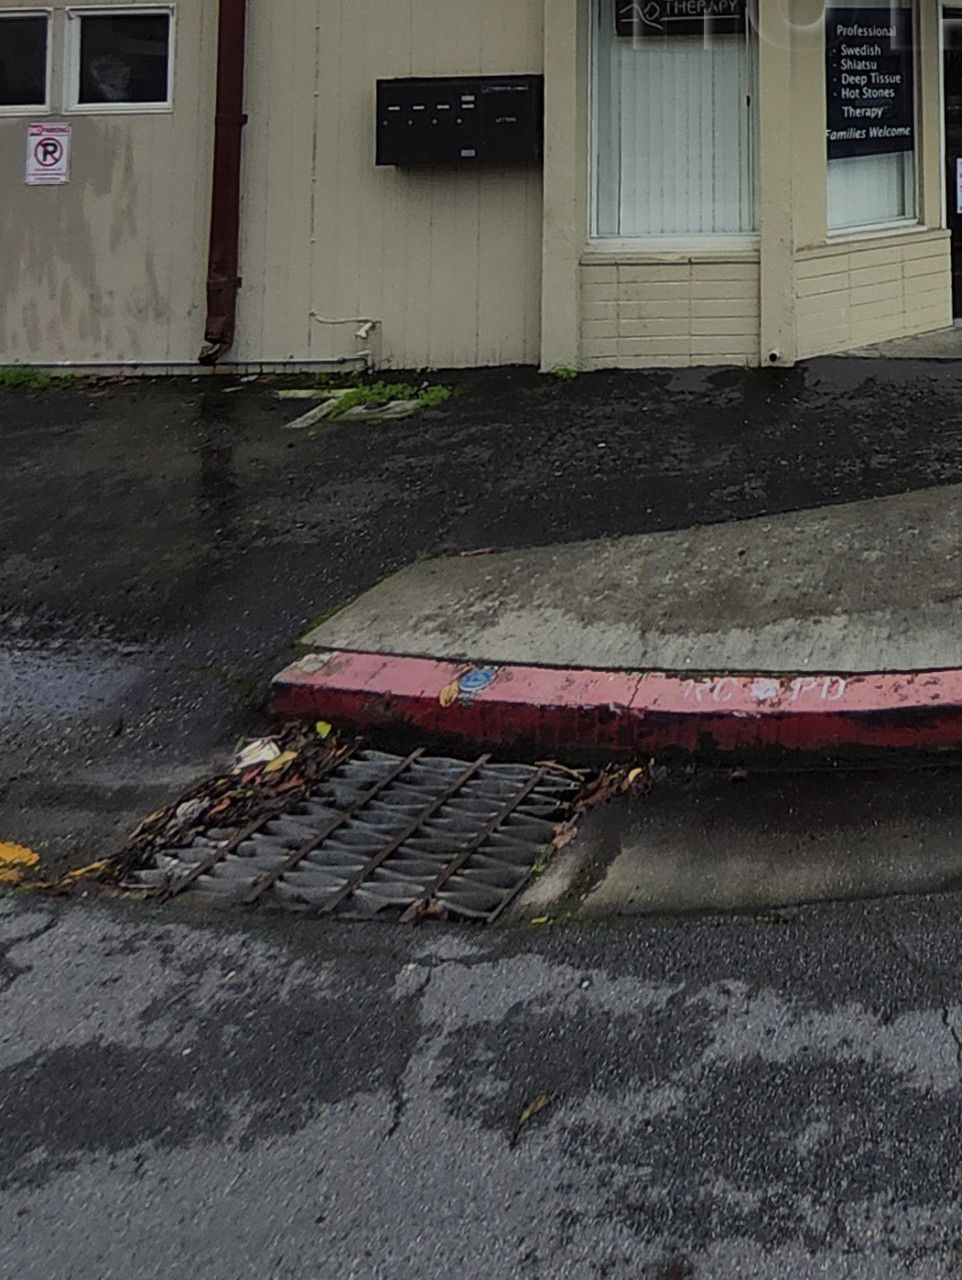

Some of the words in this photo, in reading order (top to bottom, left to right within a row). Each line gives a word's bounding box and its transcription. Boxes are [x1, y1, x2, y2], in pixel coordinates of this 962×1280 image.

[836, 23, 897, 37] Professional
[840, 43, 882, 56] Swedish
[840, 58, 878, 71] Shiatsu
[841, 72, 868, 86] Deep
[869, 72, 902, 84] Tissue
[841, 87, 860, 99] Hot
[861, 86, 896, 99] Stones
[841, 105, 884, 119] Therapy
[868, 124, 912, 138] Welcome
